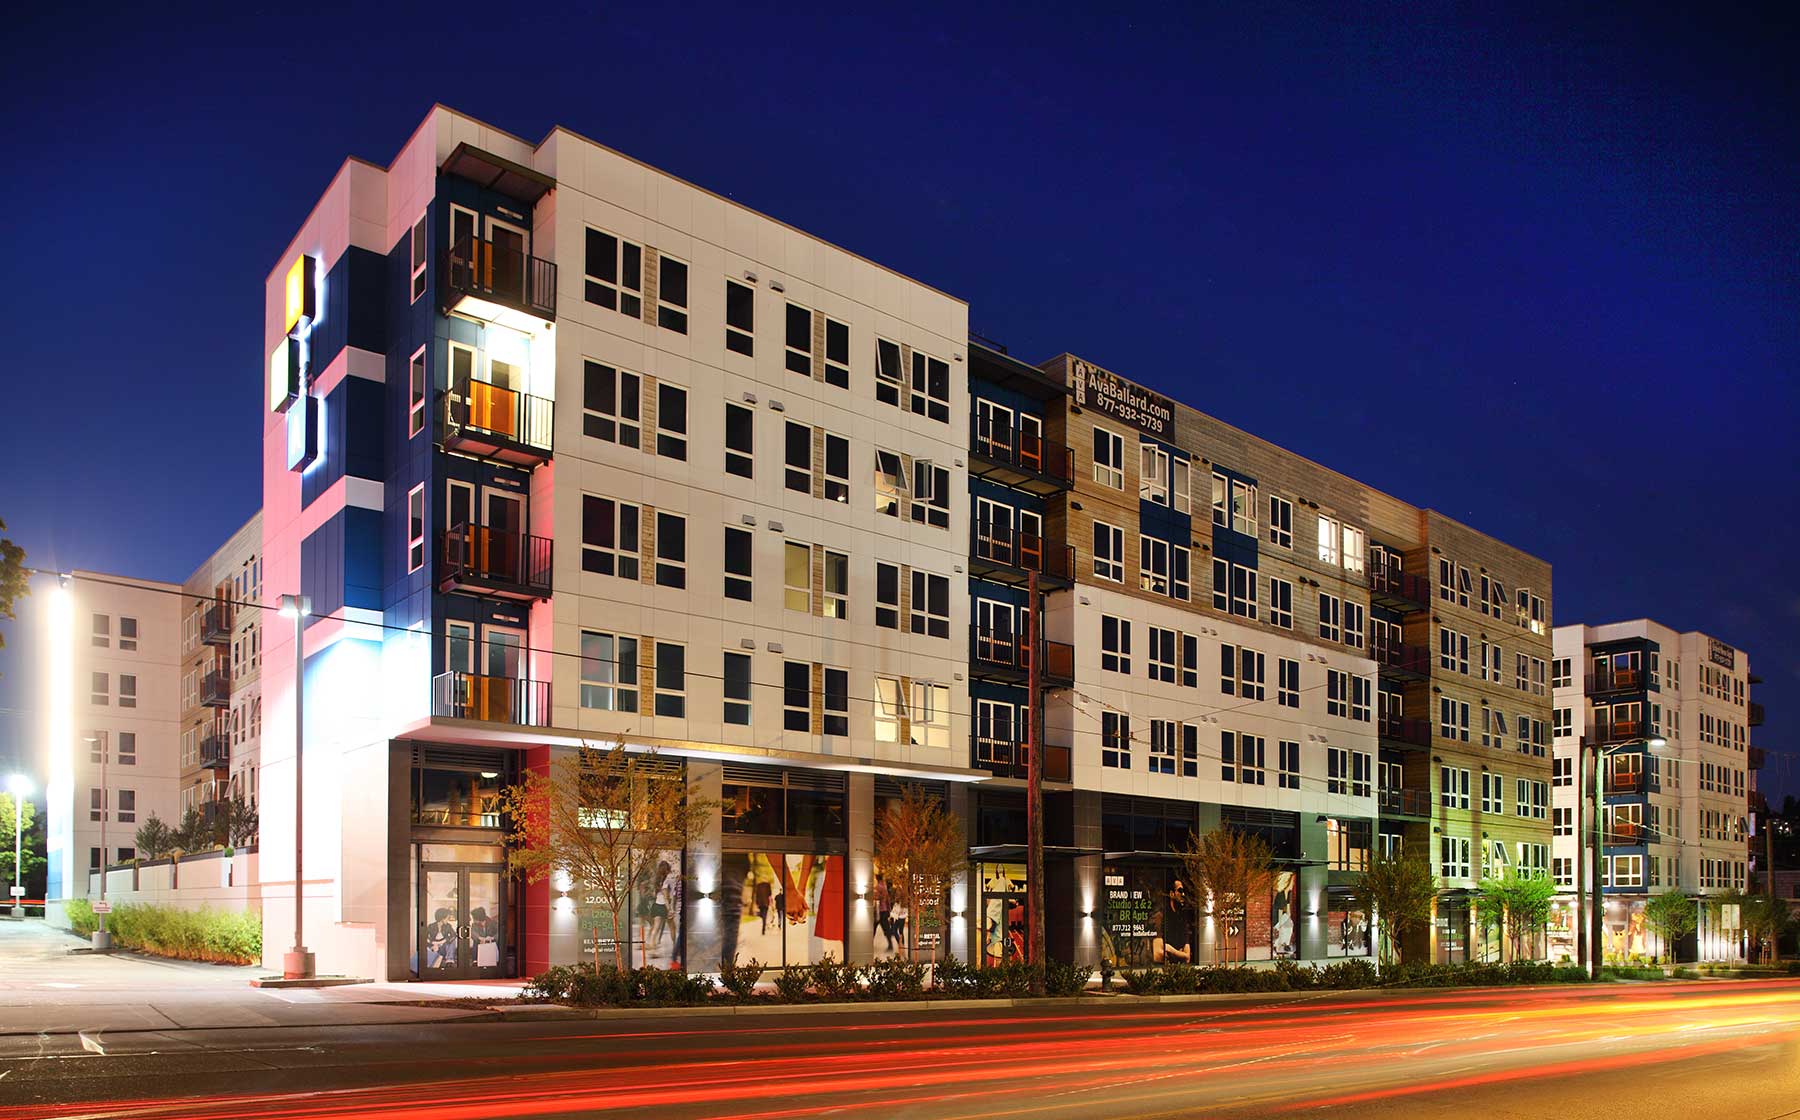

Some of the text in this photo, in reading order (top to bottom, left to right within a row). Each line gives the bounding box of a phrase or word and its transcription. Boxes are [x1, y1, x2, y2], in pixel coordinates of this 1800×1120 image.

[1088, 374, 1170, 421] AvaBallard.com
[1096, 392, 1163, 433] 877-932-5739
[1109, 890, 1129, 899] BRAND
[1107, 900, 1132, 909] Studio
[1119, 910, 1149, 922] BR Apts
